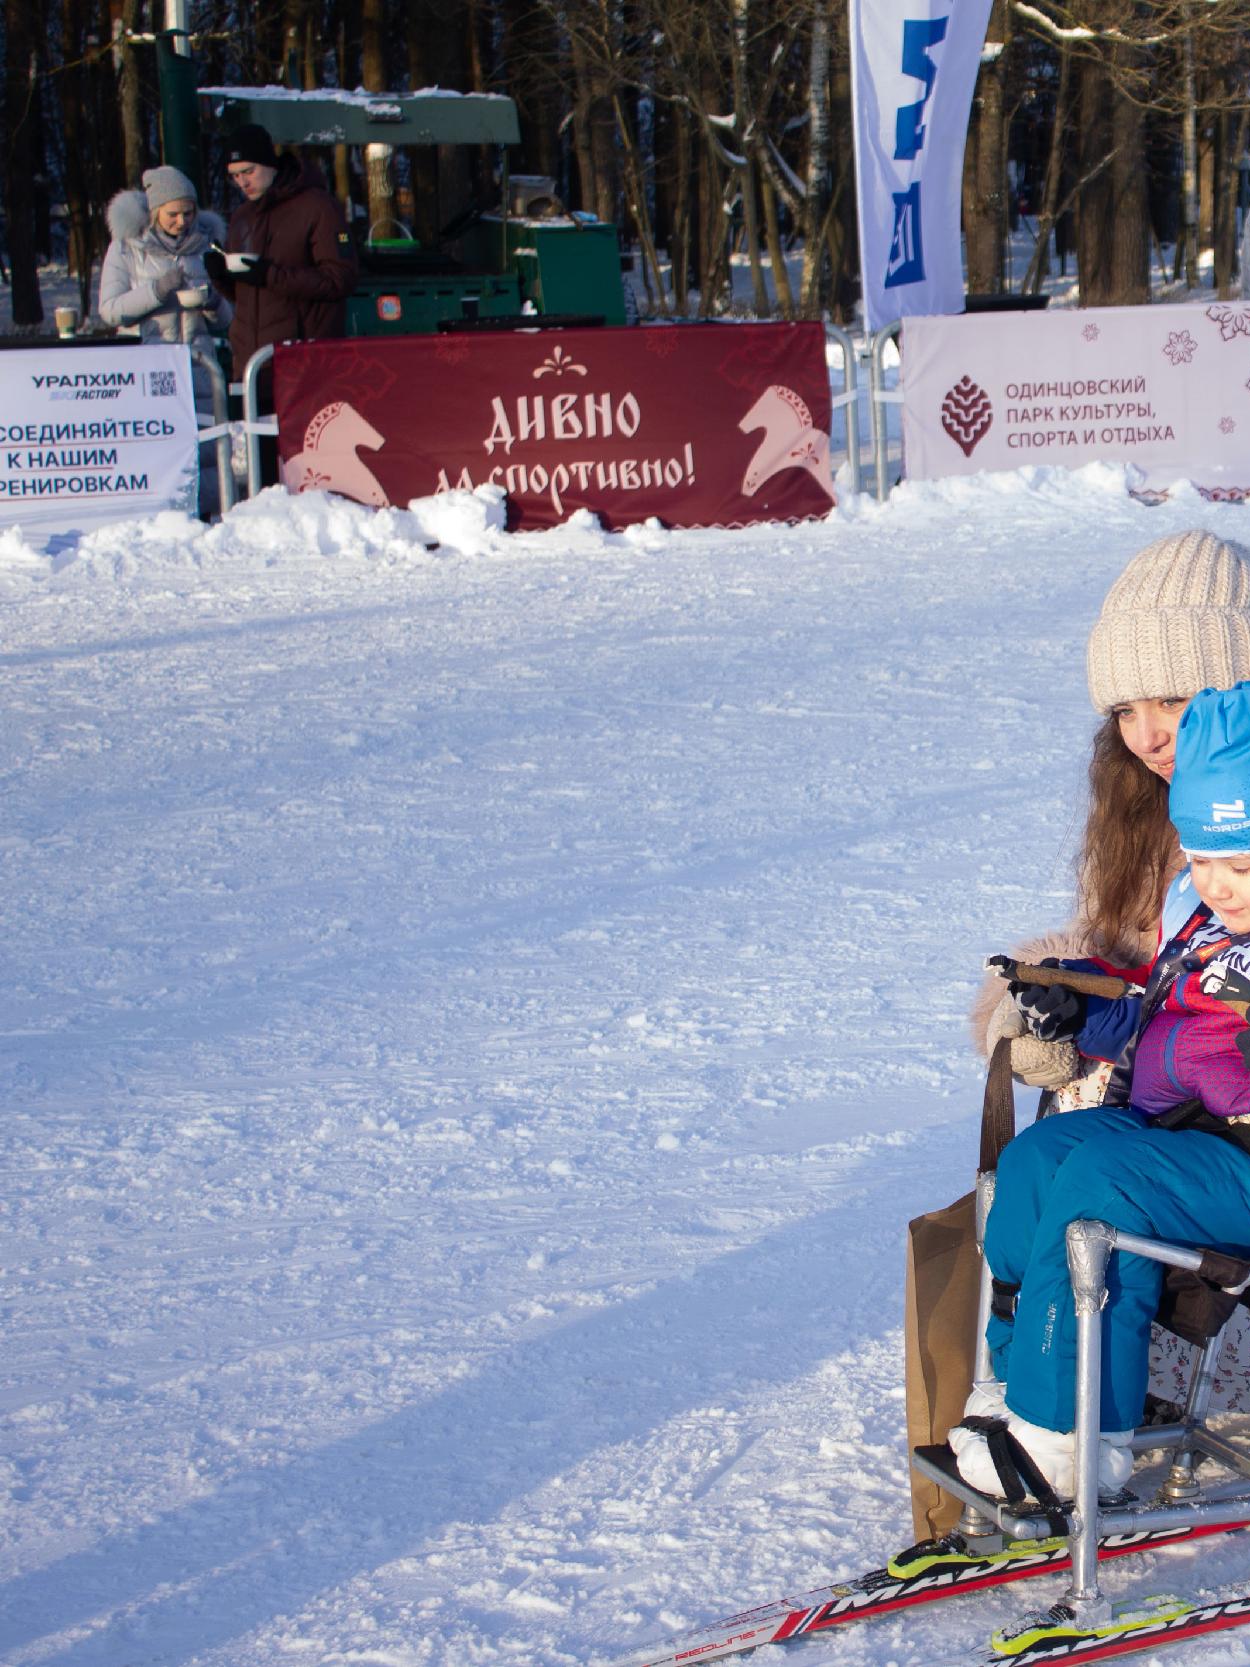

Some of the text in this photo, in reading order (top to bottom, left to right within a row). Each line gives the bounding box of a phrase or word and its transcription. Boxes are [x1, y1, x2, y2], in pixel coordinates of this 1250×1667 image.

[32, 372, 136, 389] УРАЛХИМ
[1006, 375, 1146, 401] ОДИНЦОВСКИЙ
[1007, 402, 1157, 423] ПАРК КУЛЬТУРЫ,
[483, 392, 641, 456] ДИВНО
[1007, 425, 1176, 448] СПОРТА И ОТДЫХА
[7, 448, 118, 469] К НАШИМ
